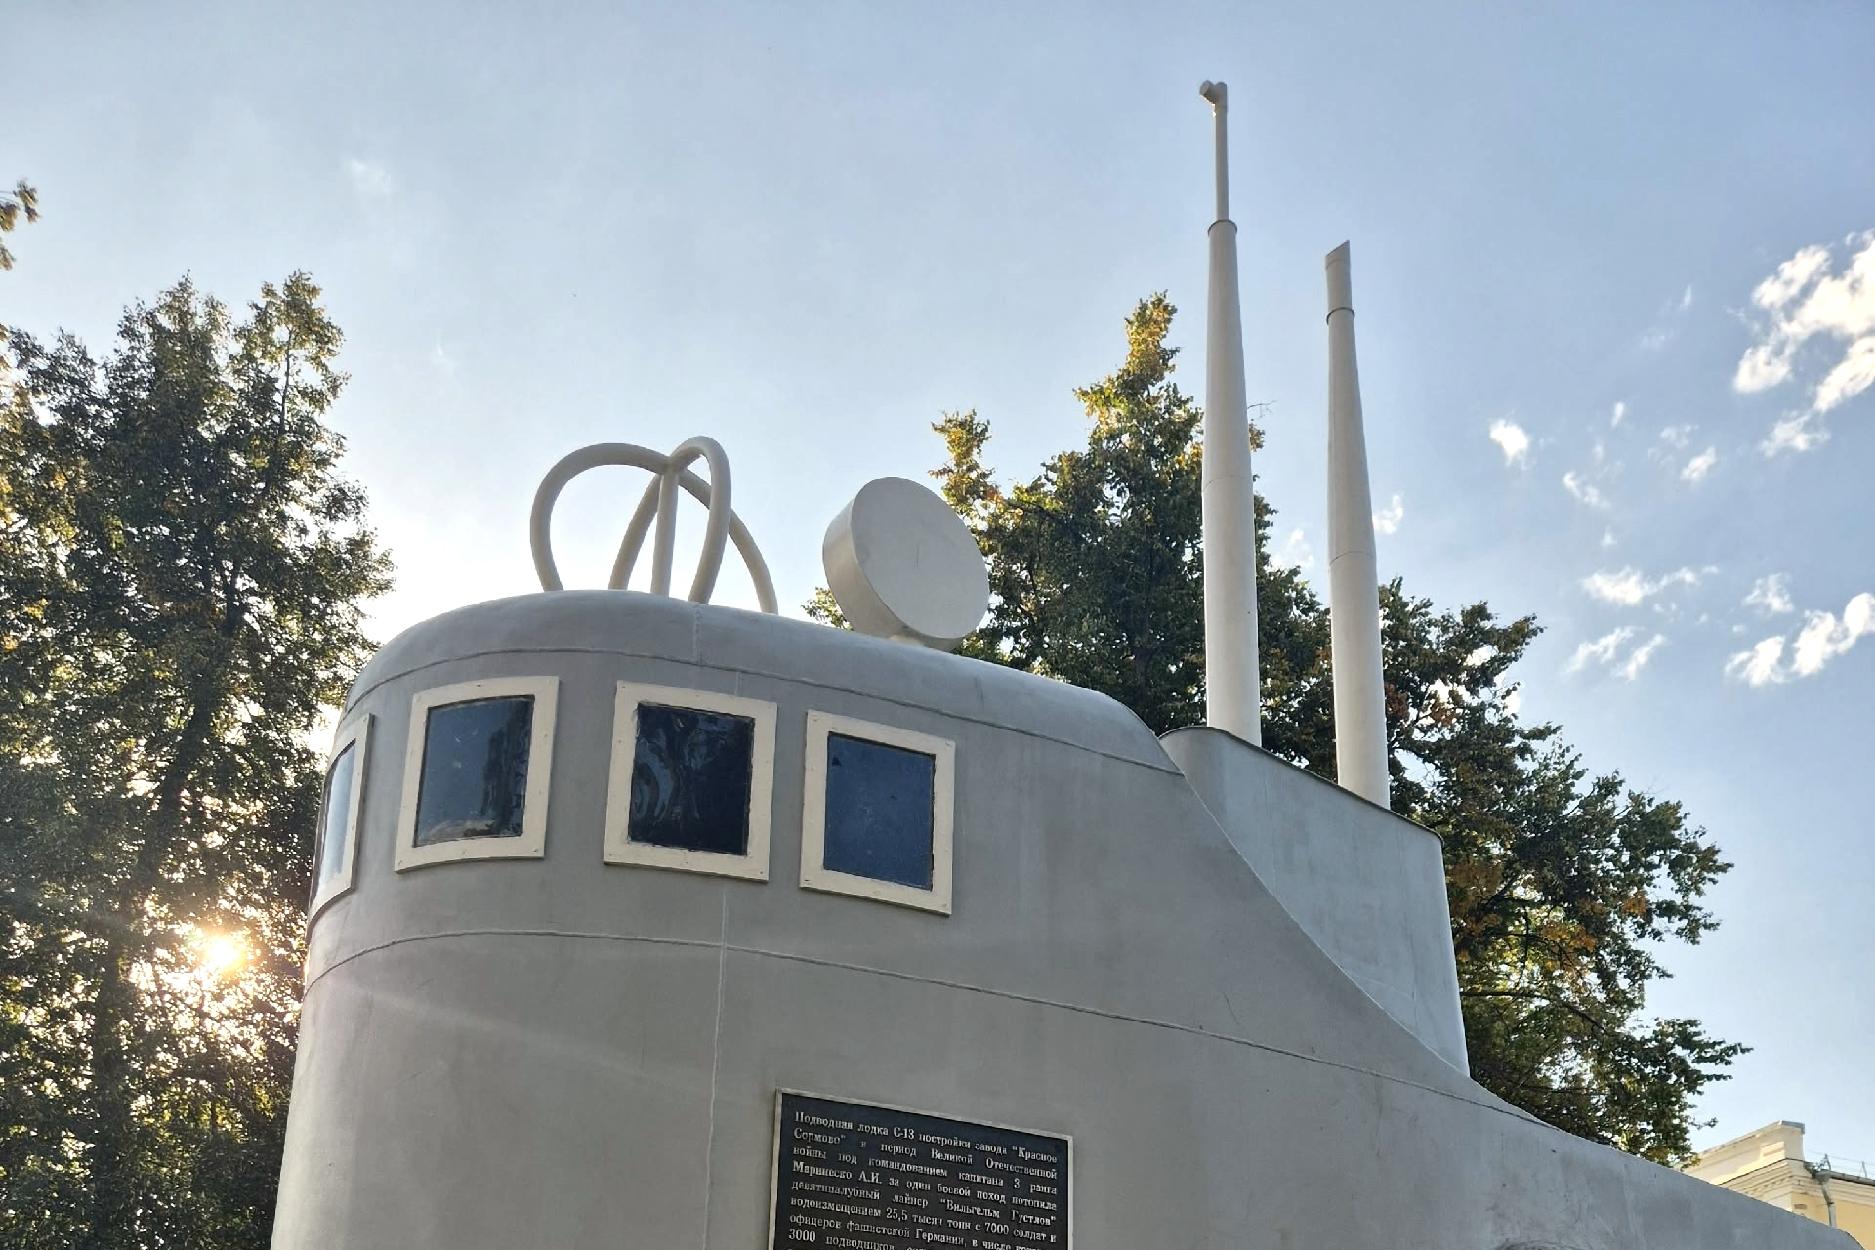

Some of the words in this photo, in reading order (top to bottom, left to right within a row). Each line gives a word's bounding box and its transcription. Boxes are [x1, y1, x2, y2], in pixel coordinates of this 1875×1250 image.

[795, 1111, 853, 1129] Подводная
[857, 1123, 889, 1135] лодка
[893, 1126, 915, 1139] С-13
[918, 1133, 971, 1148] постройки
[793, 1145, 827, 1159] войны
[838, 1153, 857, 1164] под
[868, 1158, 948, 1176] командованием
[958, 1172, 1004, 1186] капитана
[1029, 1184, 1057, 1194] ранга
[880, 1143, 917, 1157] период
[931, 1147, 973, 1164] Великой
[985, 1157, 1058, 1179] Отечественной
[792, 1160, 853, 1179] Маринеско
[888, 1177, 899, 1186] за
[906, 1180, 931, 1190] один
[937, 1183, 971, 1196] боевой
[976, 1190, 1006, 1204] поход
[1012, 1196, 1057, 1210] потопила
[892, 1192, 929, 1208] лайнер
[788, 1228, 816, 1242] 3000
[789, 1213, 842, 1229] офицеров
[846, 1220, 910, 1237] фашистской
[982, 1240, 1012, 1250] числе
[886, 1206, 908, 1221] 25,5
[946, 1219, 971, 1229] тонн
[984, 1222, 1009, 1234] 7000
[1013, 1228, 1047, 1240] солдат
